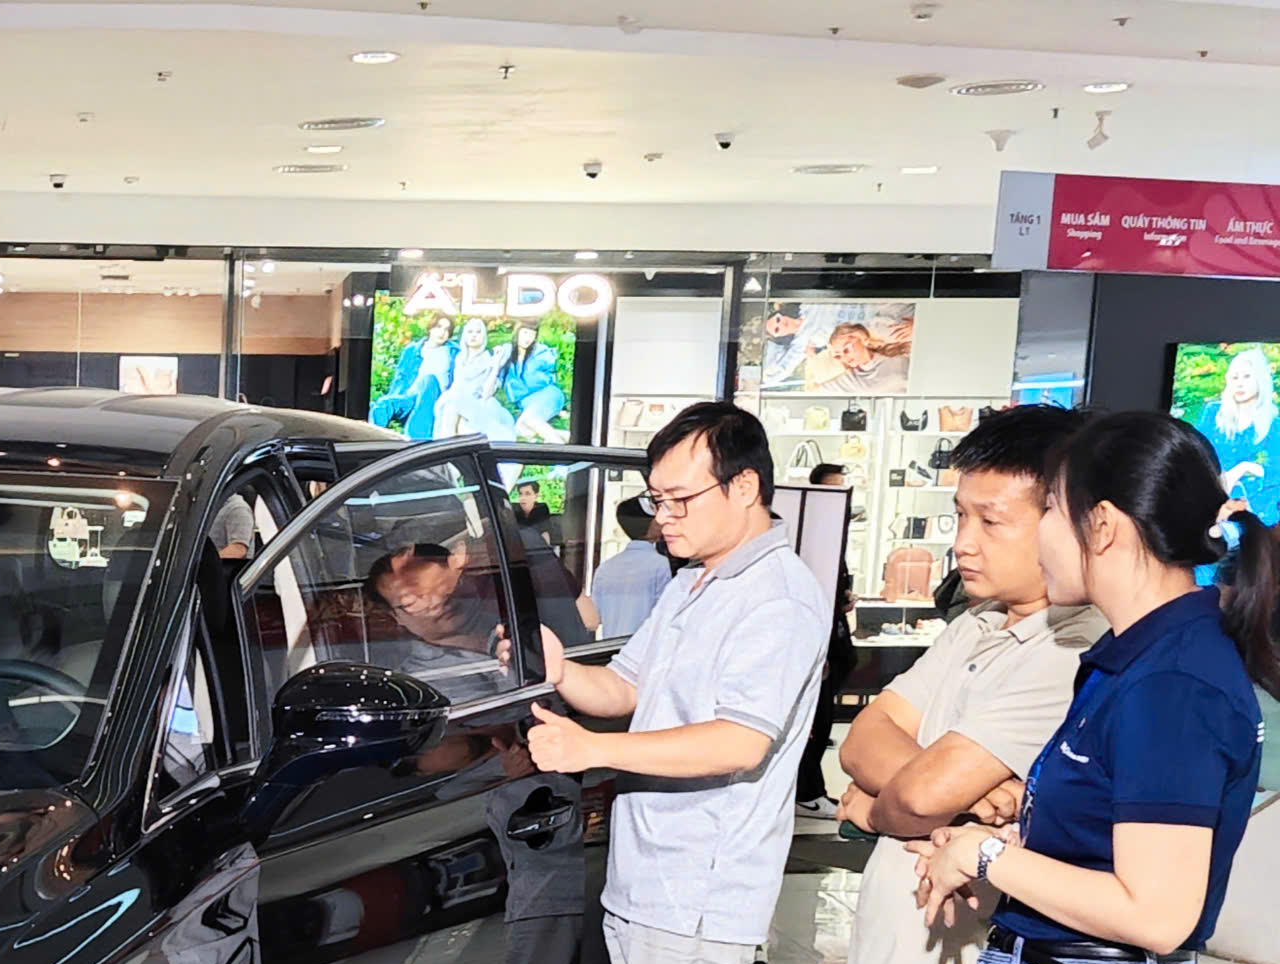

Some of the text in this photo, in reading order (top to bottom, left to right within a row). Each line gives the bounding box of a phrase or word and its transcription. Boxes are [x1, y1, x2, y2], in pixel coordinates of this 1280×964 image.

[1060, 213, 1085, 225] MUA
[1189, 218, 1207, 231] TIN
[403, 273, 613, 317] ALDO
